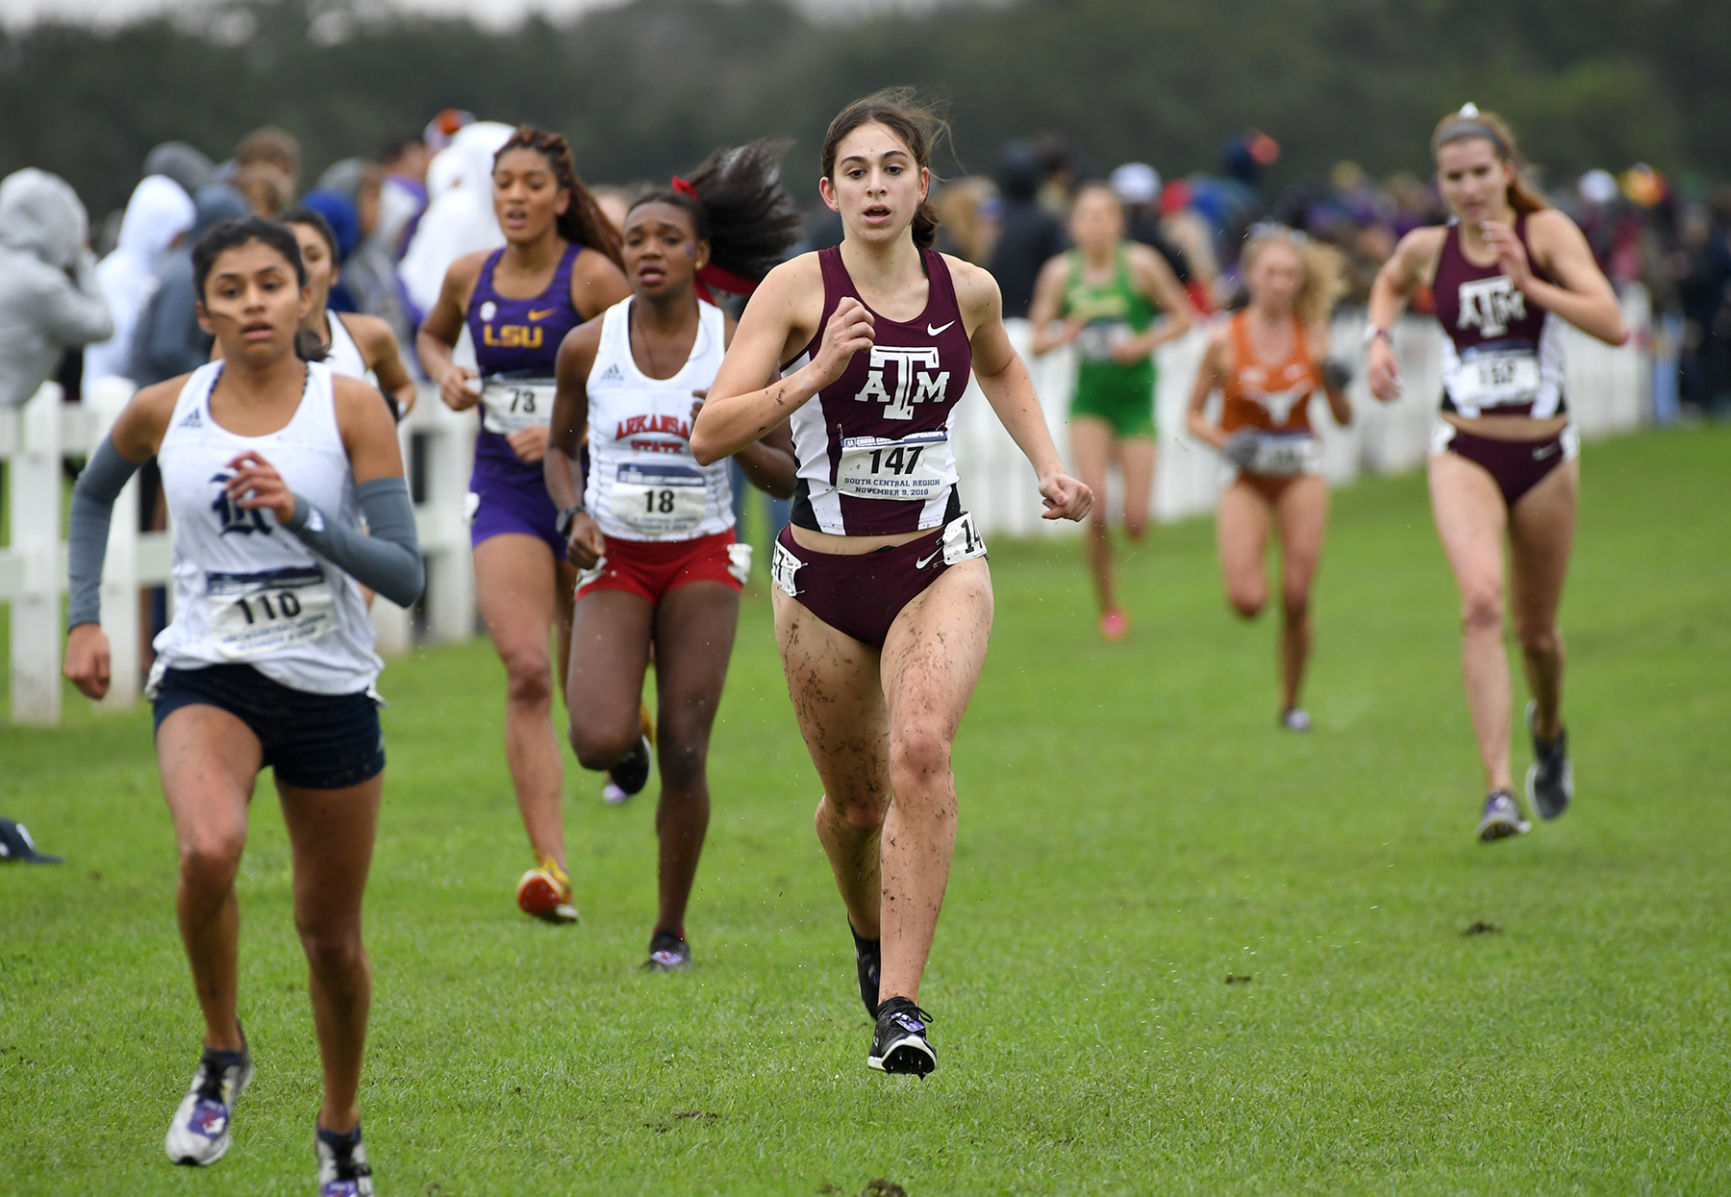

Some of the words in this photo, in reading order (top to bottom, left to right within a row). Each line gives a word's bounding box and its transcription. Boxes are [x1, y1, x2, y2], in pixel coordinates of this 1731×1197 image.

[483, 324, 544, 348] LSU
[854, 345, 950, 420] ATM
[508, 387, 537, 413] 73
[615, 414, 690, 441] ARKANSA
[869, 446, 924, 476] 147
[844, 477, 872, 485] SOUTH
[873, 479, 910, 487] CENTRAL
[855, 487, 900, 496] NOVEMBER
[910, 488, 929, 496] 2018
[644, 488, 675, 514] 18
[234, 590, 301, 625] 110
